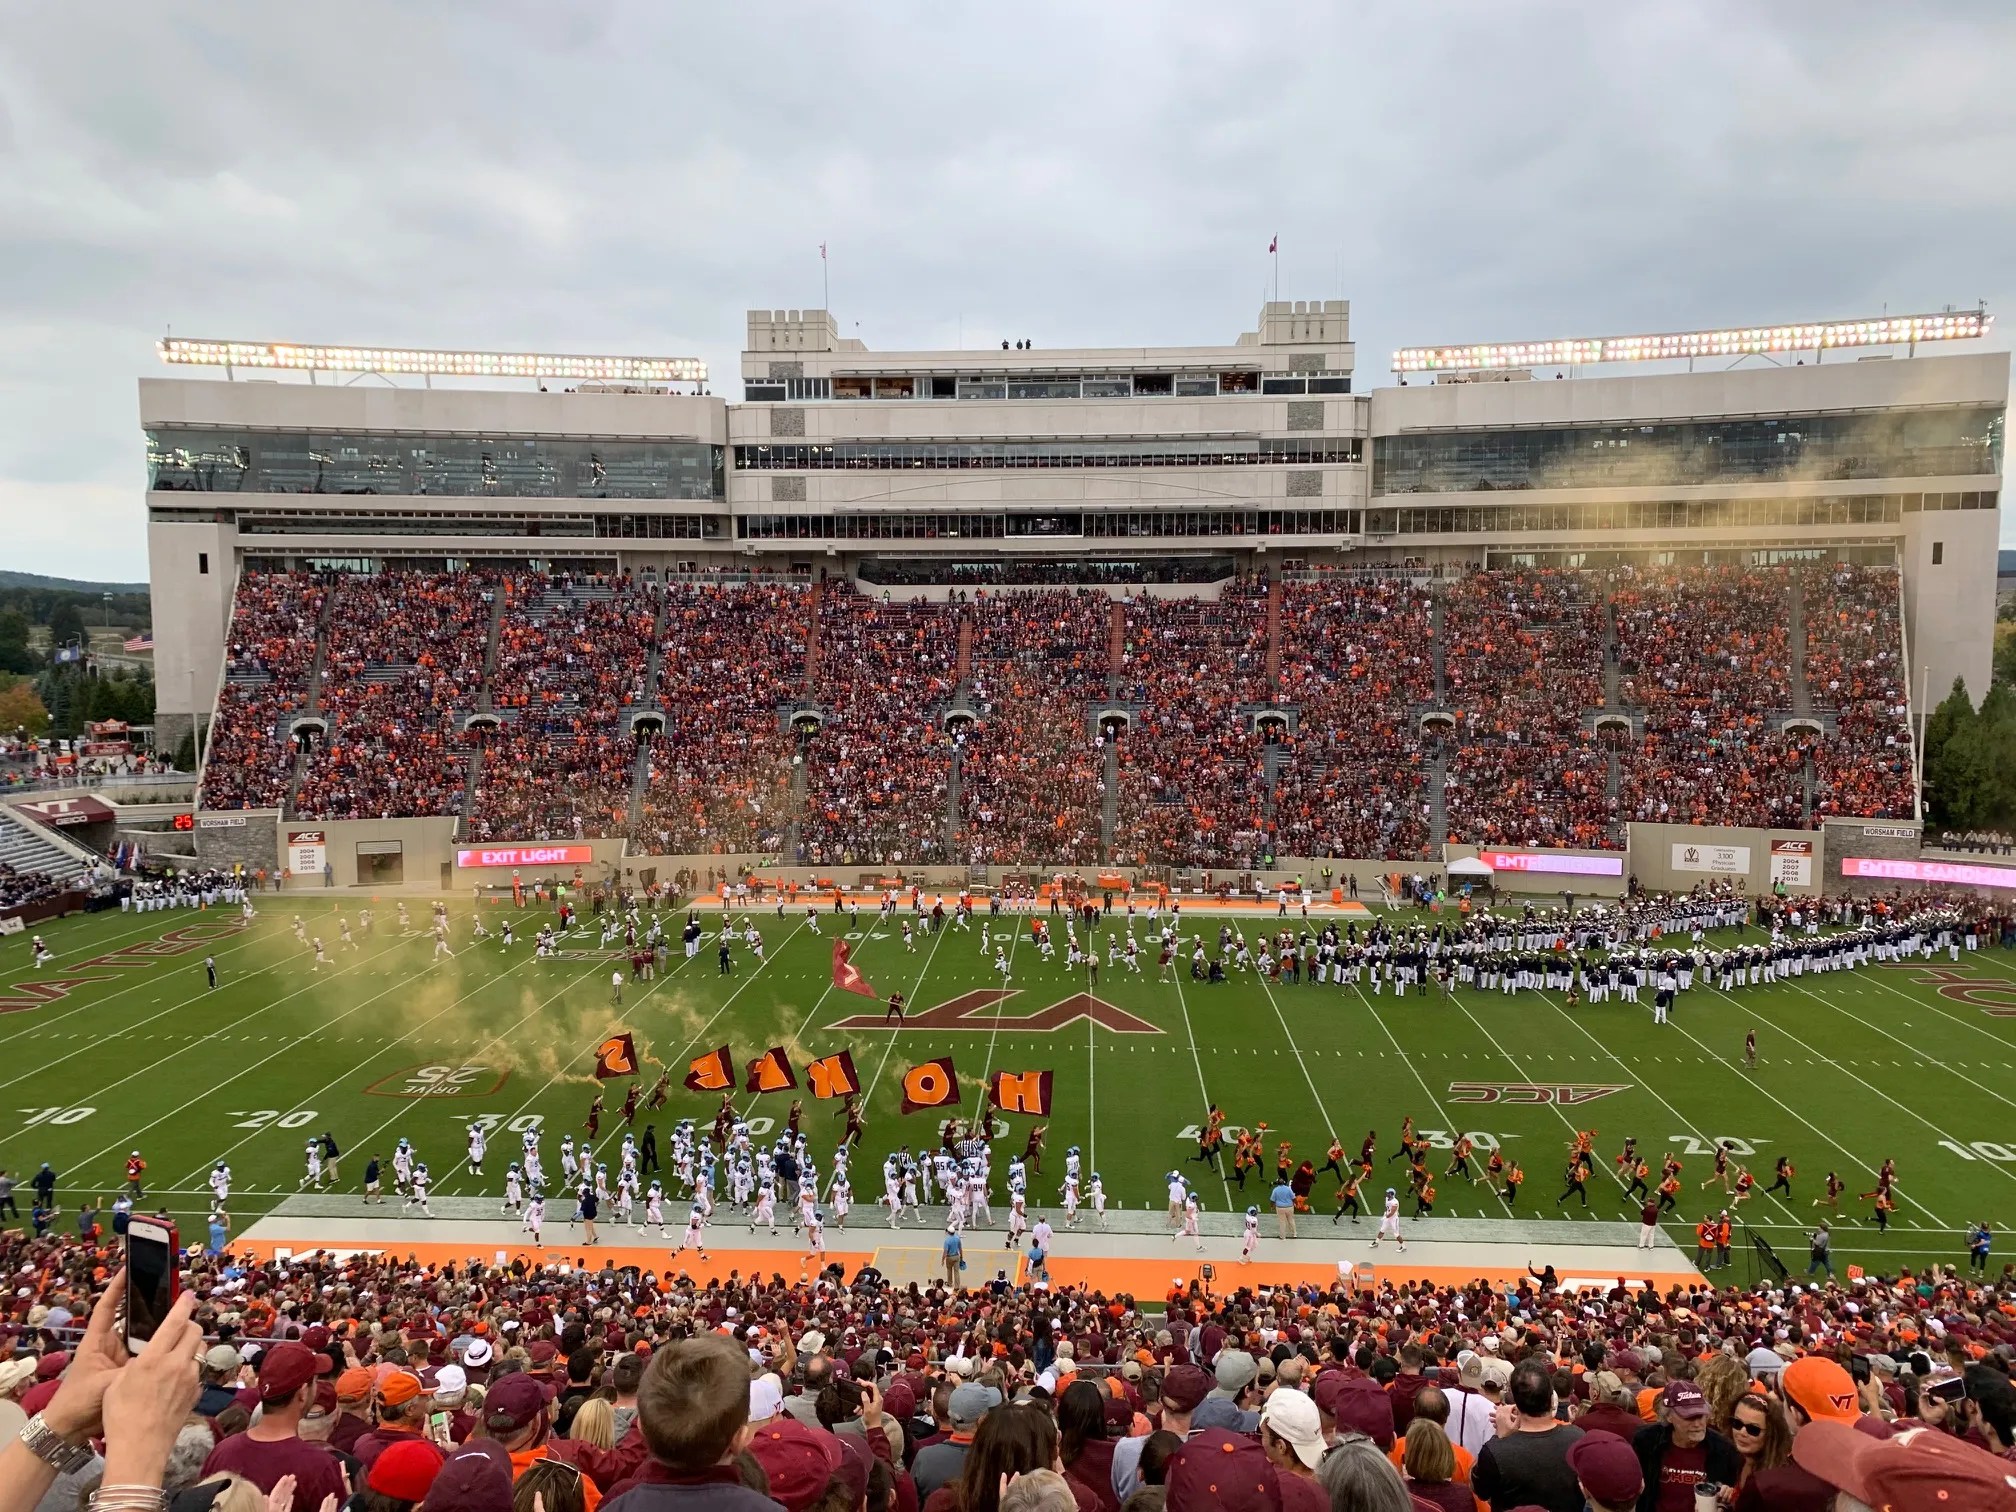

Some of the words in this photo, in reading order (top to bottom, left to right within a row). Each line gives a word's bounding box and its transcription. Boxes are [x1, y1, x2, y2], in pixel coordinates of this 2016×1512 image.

[18, 799, 79, 814] VT
[56, 816, 88, 825] GEICO
[175, 815, 192, 829] 25
[230, 818, 245, 826] FIELD
[295, 832, 321, 841] ACC
[1864, 828, 1895, 836] WORSHAM
[1777, 841, 1808, 850] ACC
[481, 851, 518, 864] EXIT
[521, 849, 568, 862] LIGHT
[1858, 861, 1917, 877] ENTER
[1446, 1081, 1635, 1105] ACC
[23, 1107, 97, 1125] 10
[232, 1110, 319, 1129] 20
[1418, 1130, 1501, 1150] 30
[1668, 1135, 1756, 1155] 20
[1938, 1141, 2016, 1161] 10
[1850, 1266, 1861, 1277] 20
[1828, 1393, 1855, 1412] VT
